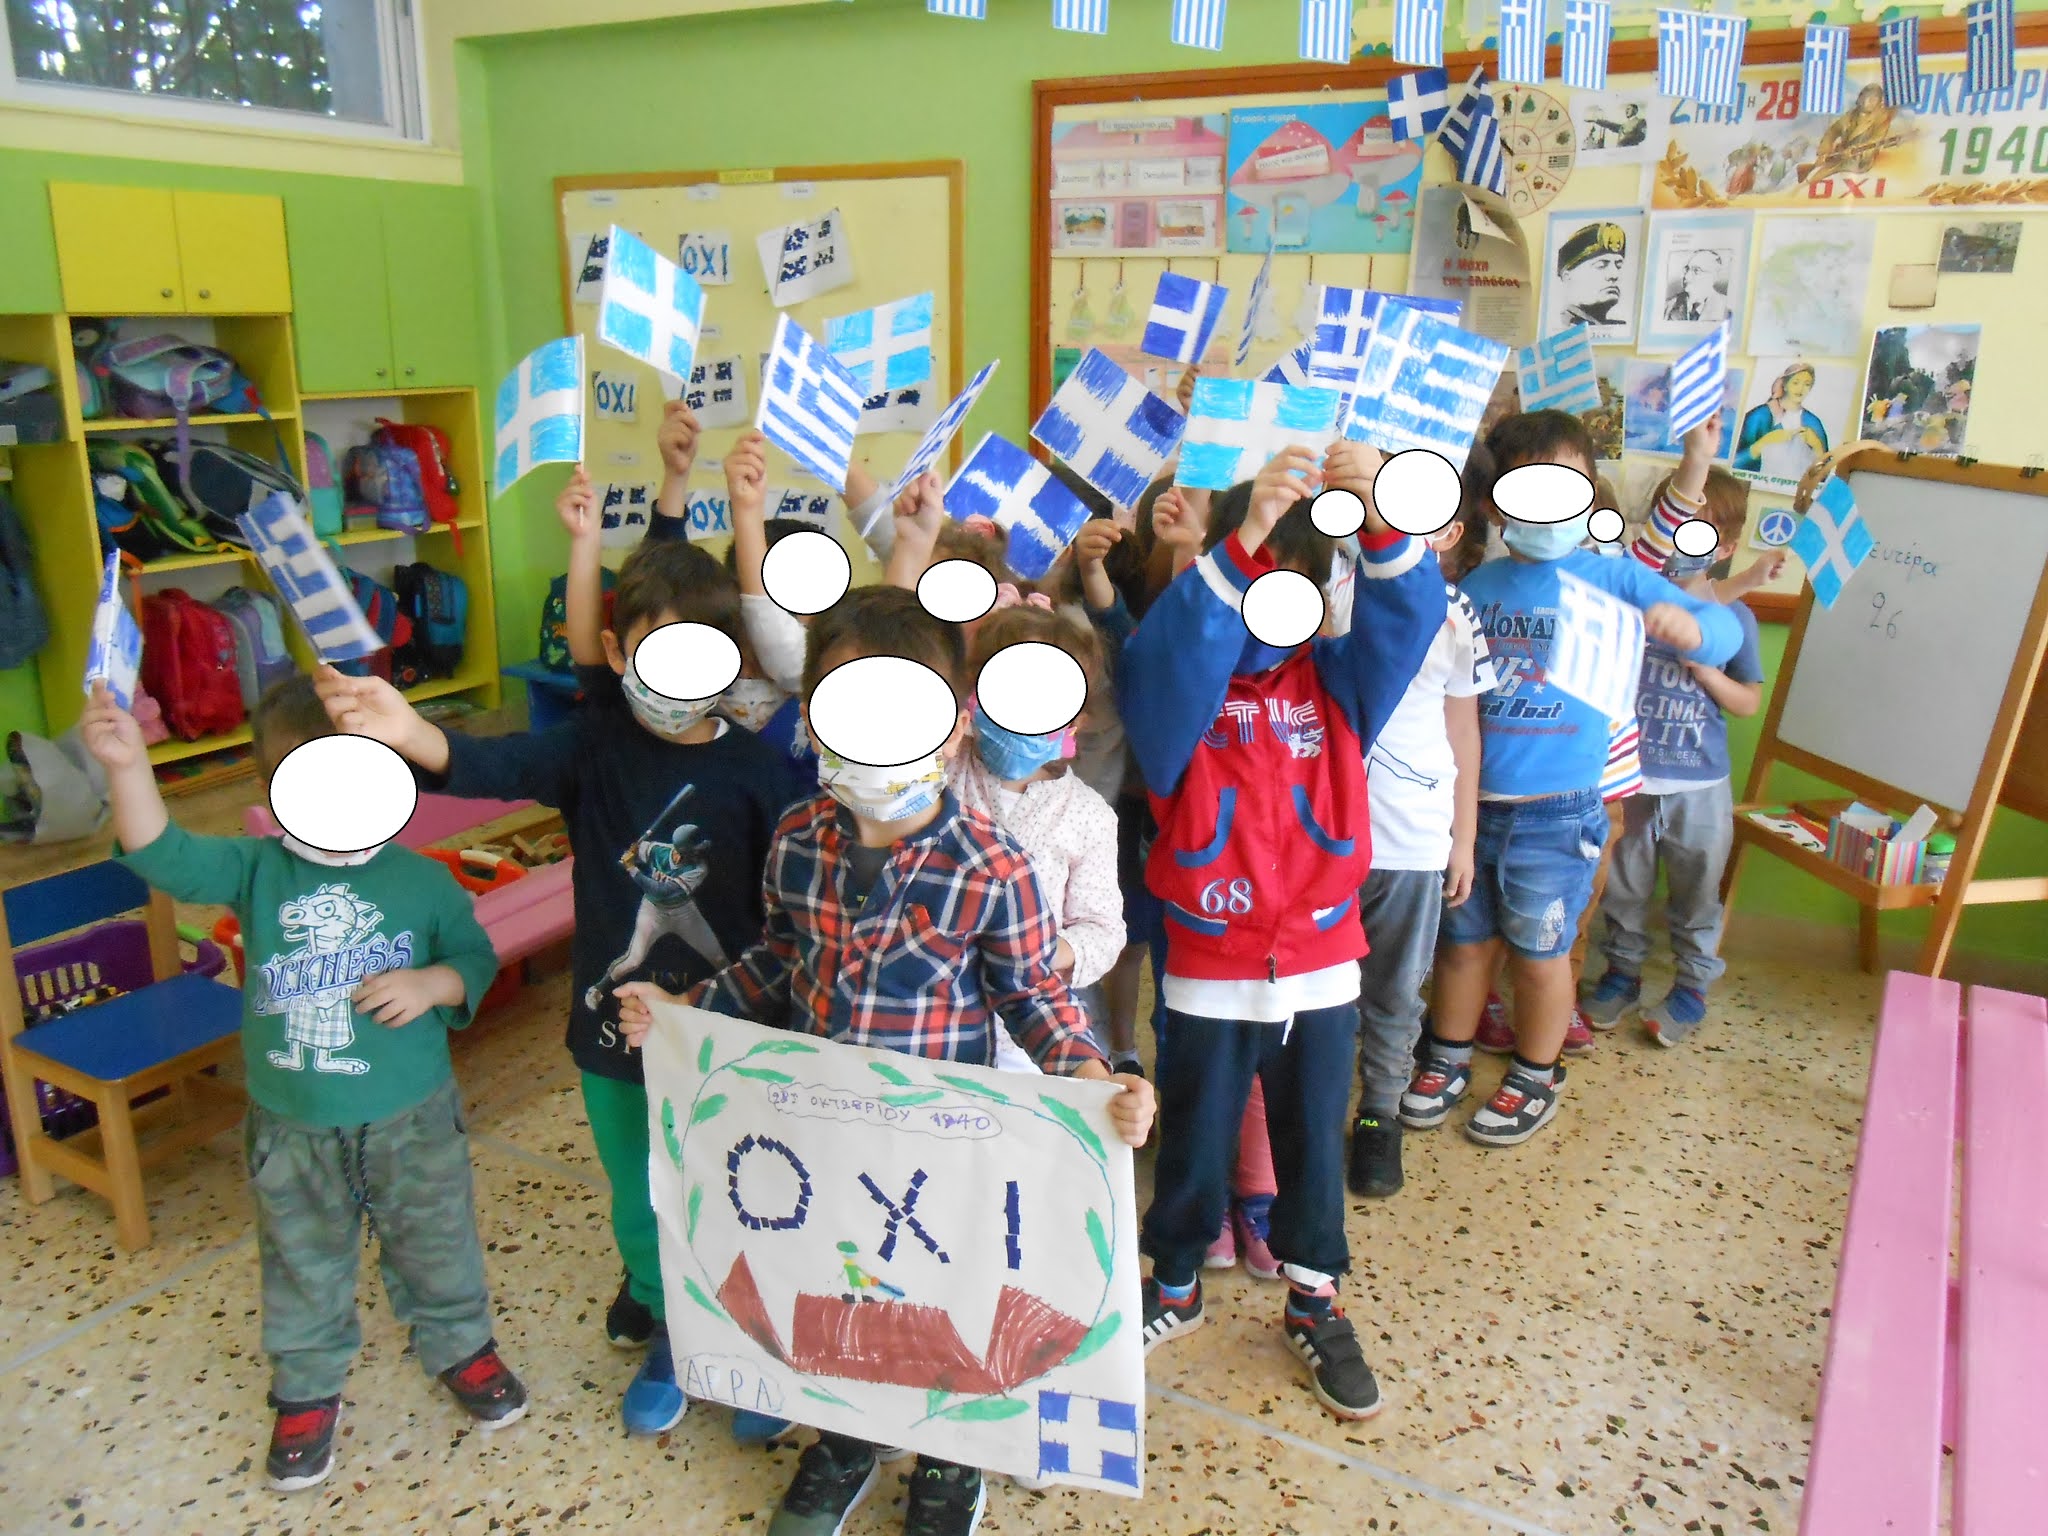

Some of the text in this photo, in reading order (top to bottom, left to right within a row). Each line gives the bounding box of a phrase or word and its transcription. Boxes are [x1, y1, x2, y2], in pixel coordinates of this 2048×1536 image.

[1756, 80, 1800, 121] 28
[1939, 124, 2048, 176] 1940
[1808, 178, 1886, 199] ΟΧΙ
[683, 245, 728, 282] ΟΧΙ
[597, 381, 634, 413] ΟΧΙ
[1868, 541, 1937, 581] ευτέρα
[1870, 592, 1903, 640] 26
[1200, 878, 1253, 914] 68
[1359, 1119, 1379, 1127] FILA
[727, 1133, 1021, 1271] ΟΧΙ
[686, 1358, 772, 1410] ΑΕΡΑ
